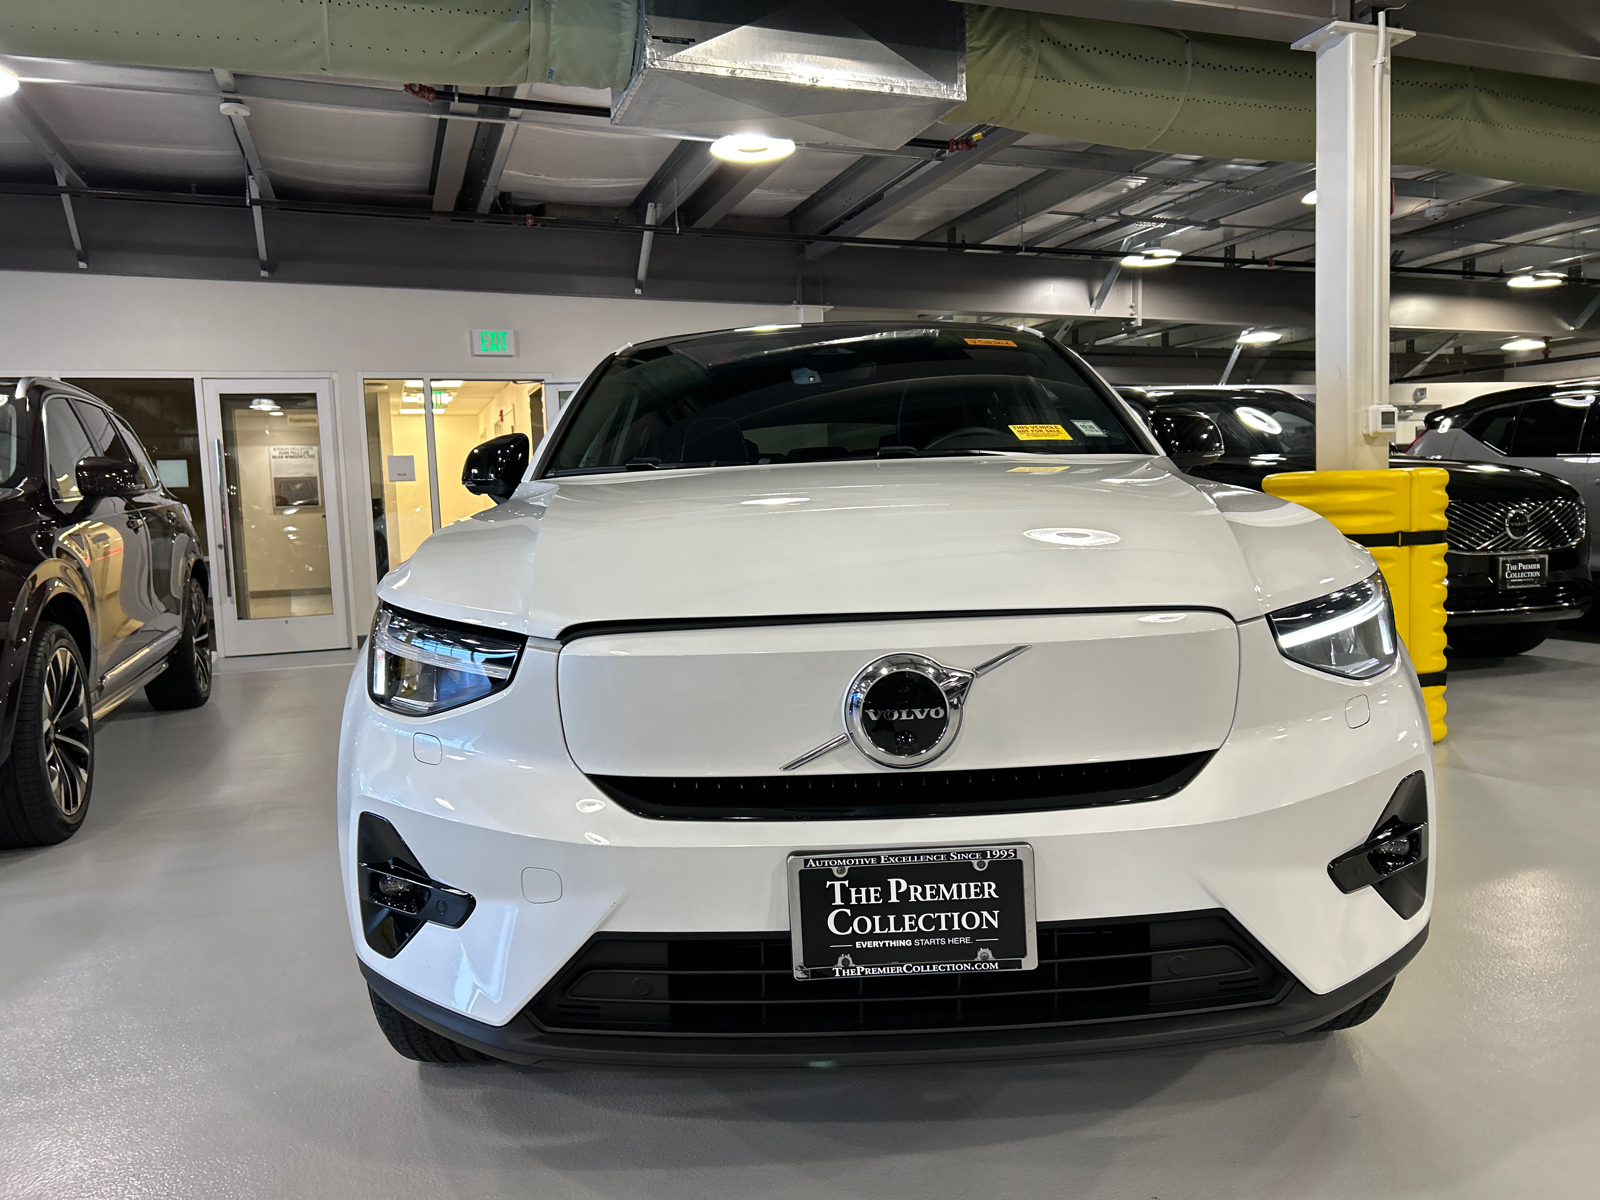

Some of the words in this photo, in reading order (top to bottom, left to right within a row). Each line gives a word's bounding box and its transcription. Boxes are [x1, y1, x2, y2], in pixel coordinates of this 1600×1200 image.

[480, 331, 507, 352] EXIT
[1505, 563, 1517, 571] THE
[1518, 562, 1540, 571] PREMIER
[1505, 570, 1541, 579] COLLECTION
[864, 706, 945, 721] VOLVO
[806, 857, 878, 868] AUTOMOTIVE
[880, 853, 947, 865] EXCELLENCE
[949, 851, 982, 861] SINCE
[986, 849, 1015, 859] 1995
[826, 880, 883, 905] THE
[887, 878, 999, 903] PREMIER
[827, 908, 1000, 936] COLLECTION
[855, 939, 912, 949] EVERYTHING
[914, 937, 946, 946] STARTS
[947, 936, 973, 945] HERE.
